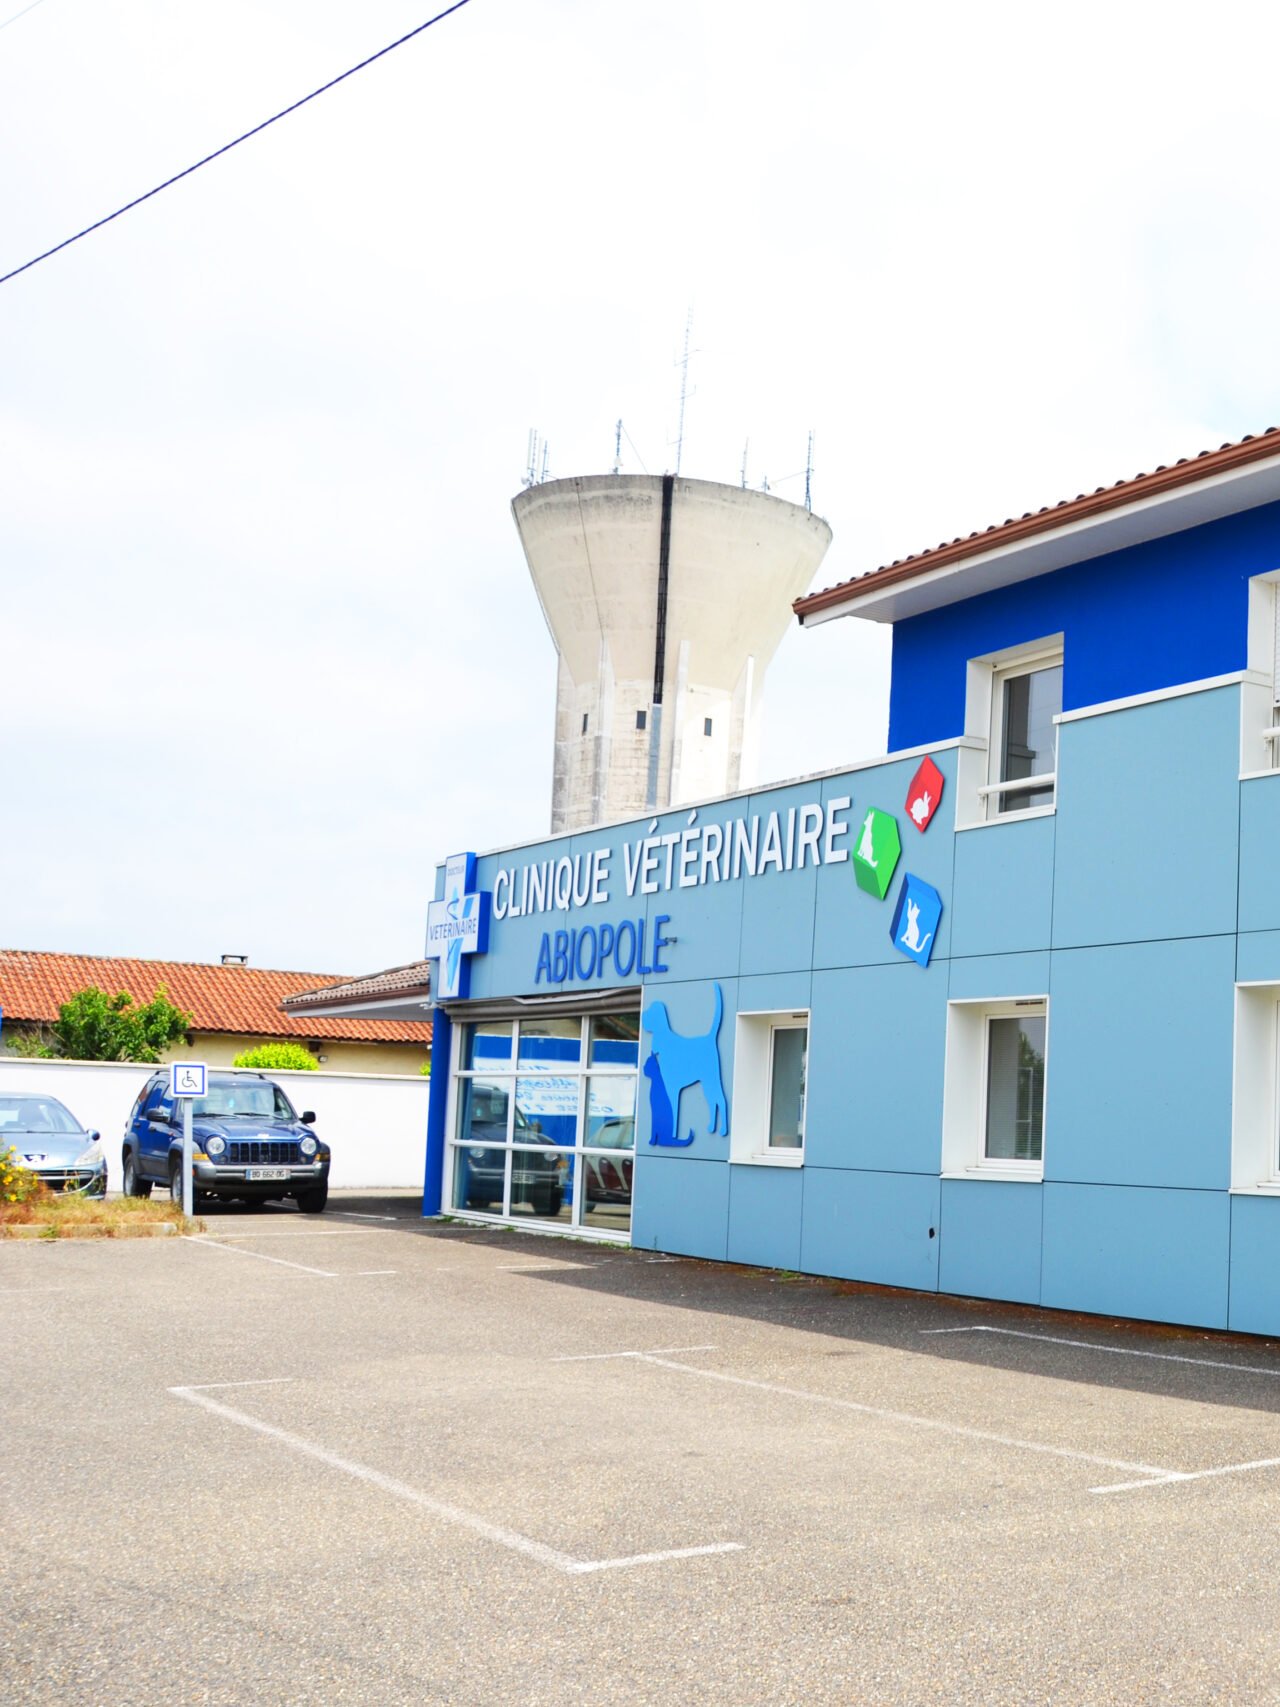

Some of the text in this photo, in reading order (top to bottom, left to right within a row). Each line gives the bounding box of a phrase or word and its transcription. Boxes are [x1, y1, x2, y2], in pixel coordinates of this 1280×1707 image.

[493, 795, 852, 920] CLINIQUE VÉTÉRINAIRE
[534, 914, 671, 985] ABIOPOLE
